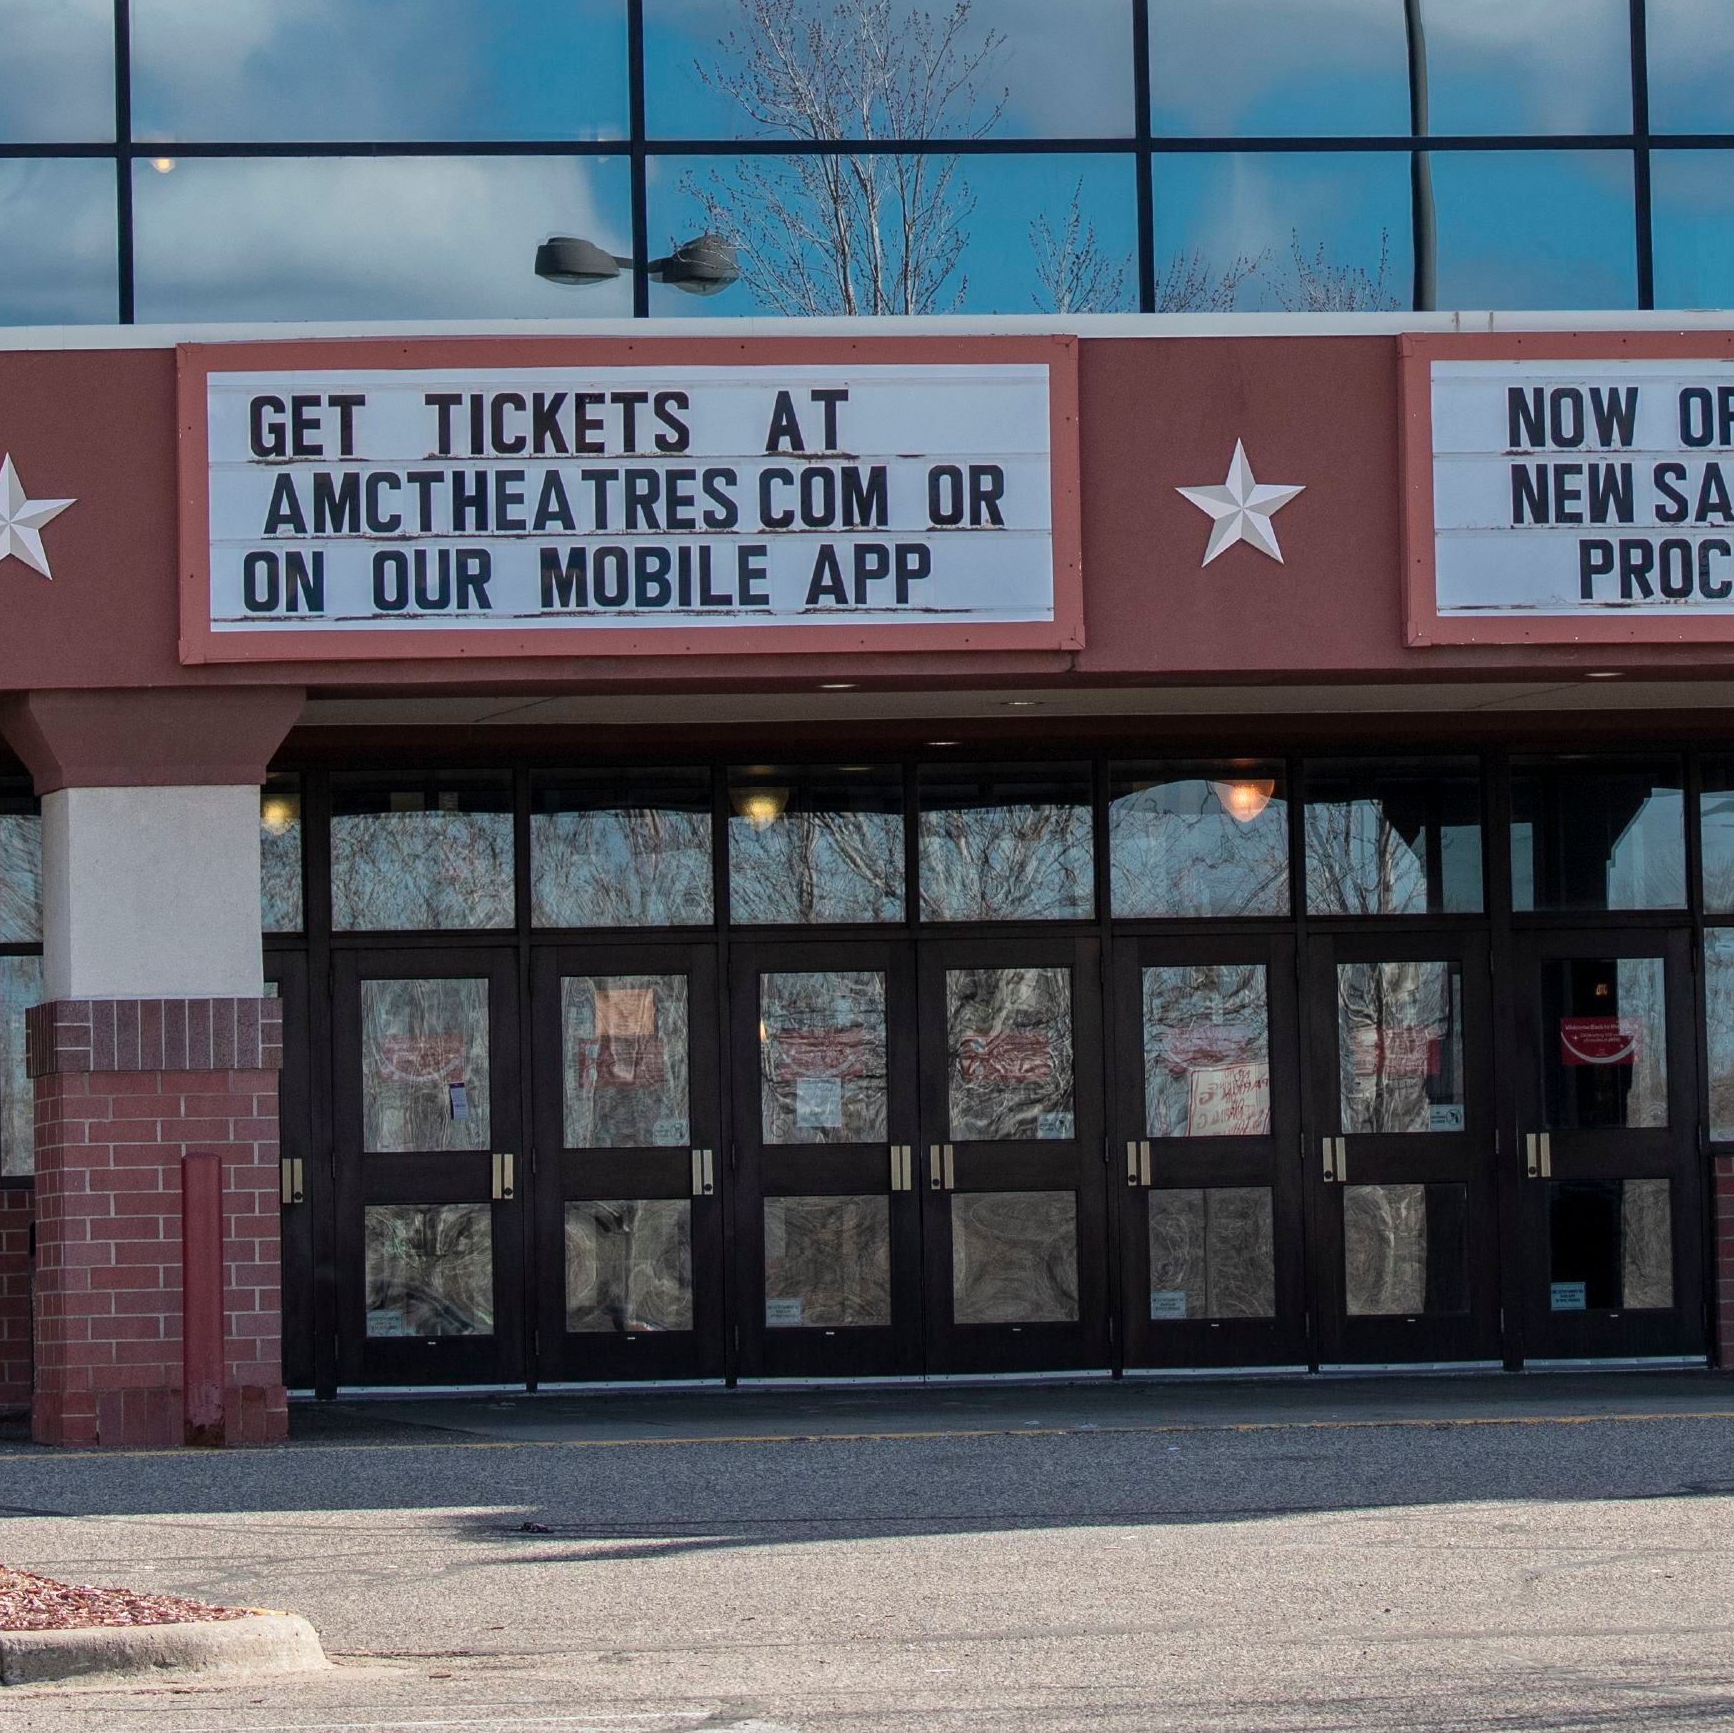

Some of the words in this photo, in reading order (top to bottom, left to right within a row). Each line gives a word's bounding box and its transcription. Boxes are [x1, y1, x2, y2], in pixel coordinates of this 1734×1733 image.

[249, 393, 366, 459] GET
[426, 392, 690, 455] TICKETS
[766, 389, 850, 452] AT
[1507, 385, 1638, 449] NOW
[928, 464, 1005, 526] OR
[1511, 463, 1635, 525] NEW
[242, 550, 324, 612] ON
[372, 548, 492, 612] OUR
[540, 544, 770, 608] MOBILE
[806, 542, 931, 605] APP
